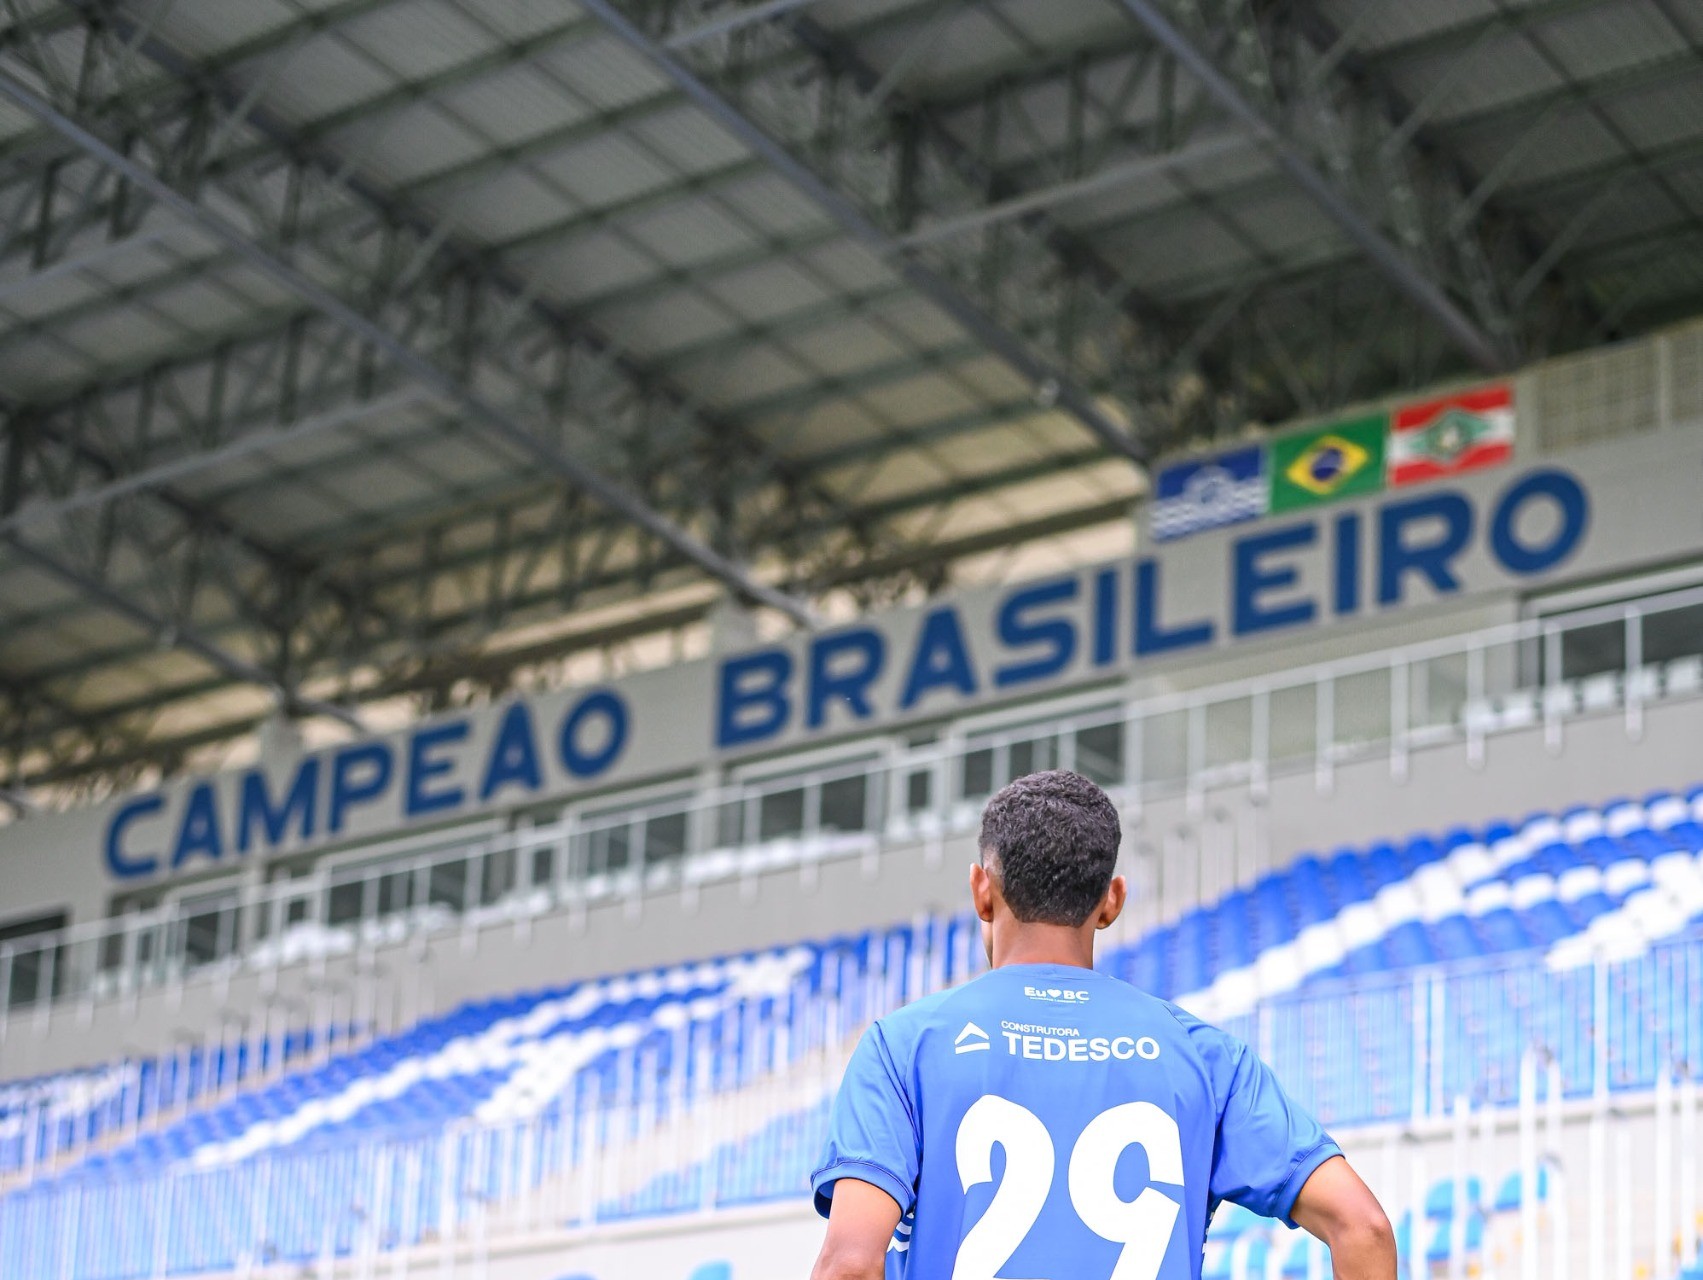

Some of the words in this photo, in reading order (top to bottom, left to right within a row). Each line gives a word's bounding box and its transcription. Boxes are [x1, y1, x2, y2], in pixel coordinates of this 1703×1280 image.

[714, 466, 1590, 748] BRASILEIRO
[1000, 1020, 1080, 1037] CONSTRUTORA
[1001, 1031, 1160, 1061] TEDESCO
